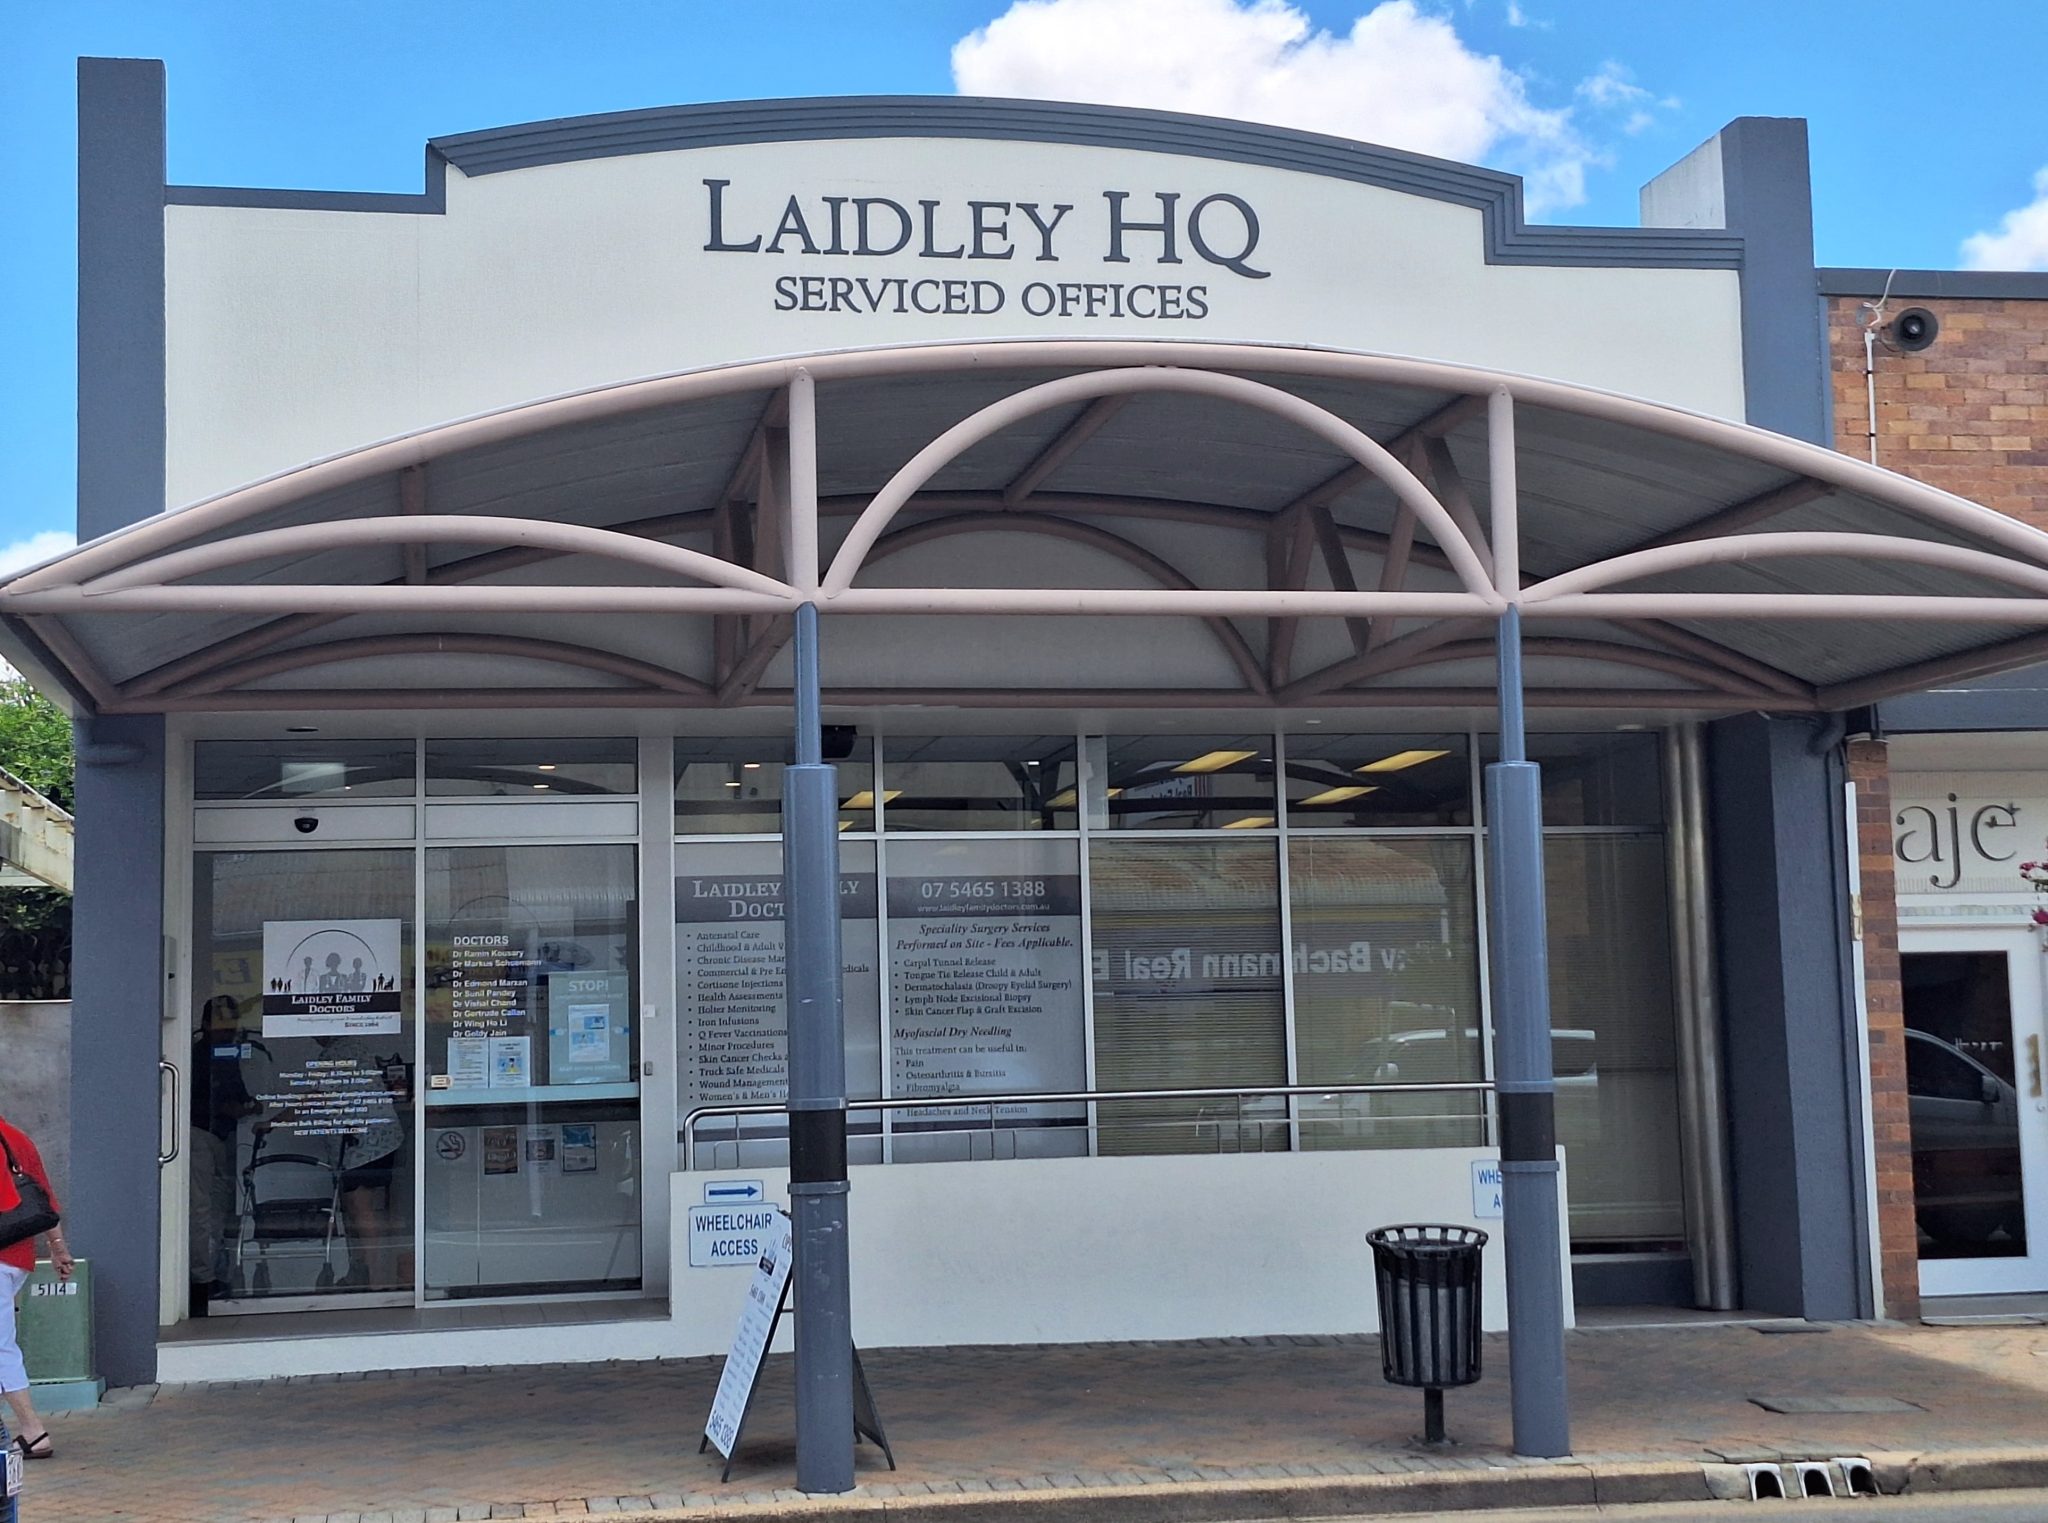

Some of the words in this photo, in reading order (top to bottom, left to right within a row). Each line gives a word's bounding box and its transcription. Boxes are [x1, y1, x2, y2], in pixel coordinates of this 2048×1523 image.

[702, 179, 1074, 261] LAIDLEY
[1103, 191, 1271, 279] HQ
[774, 276, 1005, 314] SERVICED
[1021, 282, 1208, 319] OFFICES
[692, 880, 781, 898] LAIDLEY
[922, 882, 944, 898] 07
[950, 882, 994, 897] 5465
[1001, 881, 1045, 896] 1388
[919, 924, 968, 936] Speciality
[970, 923, 1008, 935] Surgery
[1012, 922, 1050, 933] Services
[741, 931, 760, 939] Care
[454, 936, 509, 945] DOCTORS
[896, 939, 947, 952] Performed
[965, 939, 984, 948] Site
[994, 939, 1015, 948] Fees
[697, 943, 741, 952] Childhood
[753, 942, 775, 950] Adult
[698, 955, 731, 964] Chronic
[904, 971, 935, 981] Tongue
[1018, 968, 1041, 977] Adult
[697, 981, 739, 989] Cortisone
[291, 995, 333, 1004] LAIDLEY
[336, 994, 372, 1003] FAMILY
[698, 992, 726, 1001] Health
[905, 994, 934, 1005] Lymph
[936, 994, 958, 1003] Node
[309, 1005, 355, 1013] DOCTORS
[905, 1007, 923, 1016] Skin
[926, 1007, 954, 1015] Cancer
[698, 1019, 716, 1027] Iron
[719, 1017, 759, 1026] Infusions
[698, 1031, 706, 1040] Q
[894, 1027, 946, 1039] Myofascial
[949, 1027, 967, 1038] Dry
[970, 1026, 1012, 1037] Needling
[699, 1043, 725, 1051] Minor
[728, 1040, 774, 1051] Procedures
[894, 1046, 913, 1056] This
[916, 1045, 956, 1054] treatment
[976, 1044, 984, 1053] be
[699, 1055, 718, 1064] Skin
[721, 1054, 749, 1063] Cancer
[906, 1060, 924, 1068] Pain
[699, 1067, 723, 1077] Truck
[747, 1064, 784, 1074] Medicals
[699, 1079, 731, 1088] Wound
[953, 1107, 969, 1115] and
[696, 1212, 772, 1232] WHEELCHAIR
[711, 1239, 758, 1257] ACCESS
[38, 1283, 66, 1296] 5114
